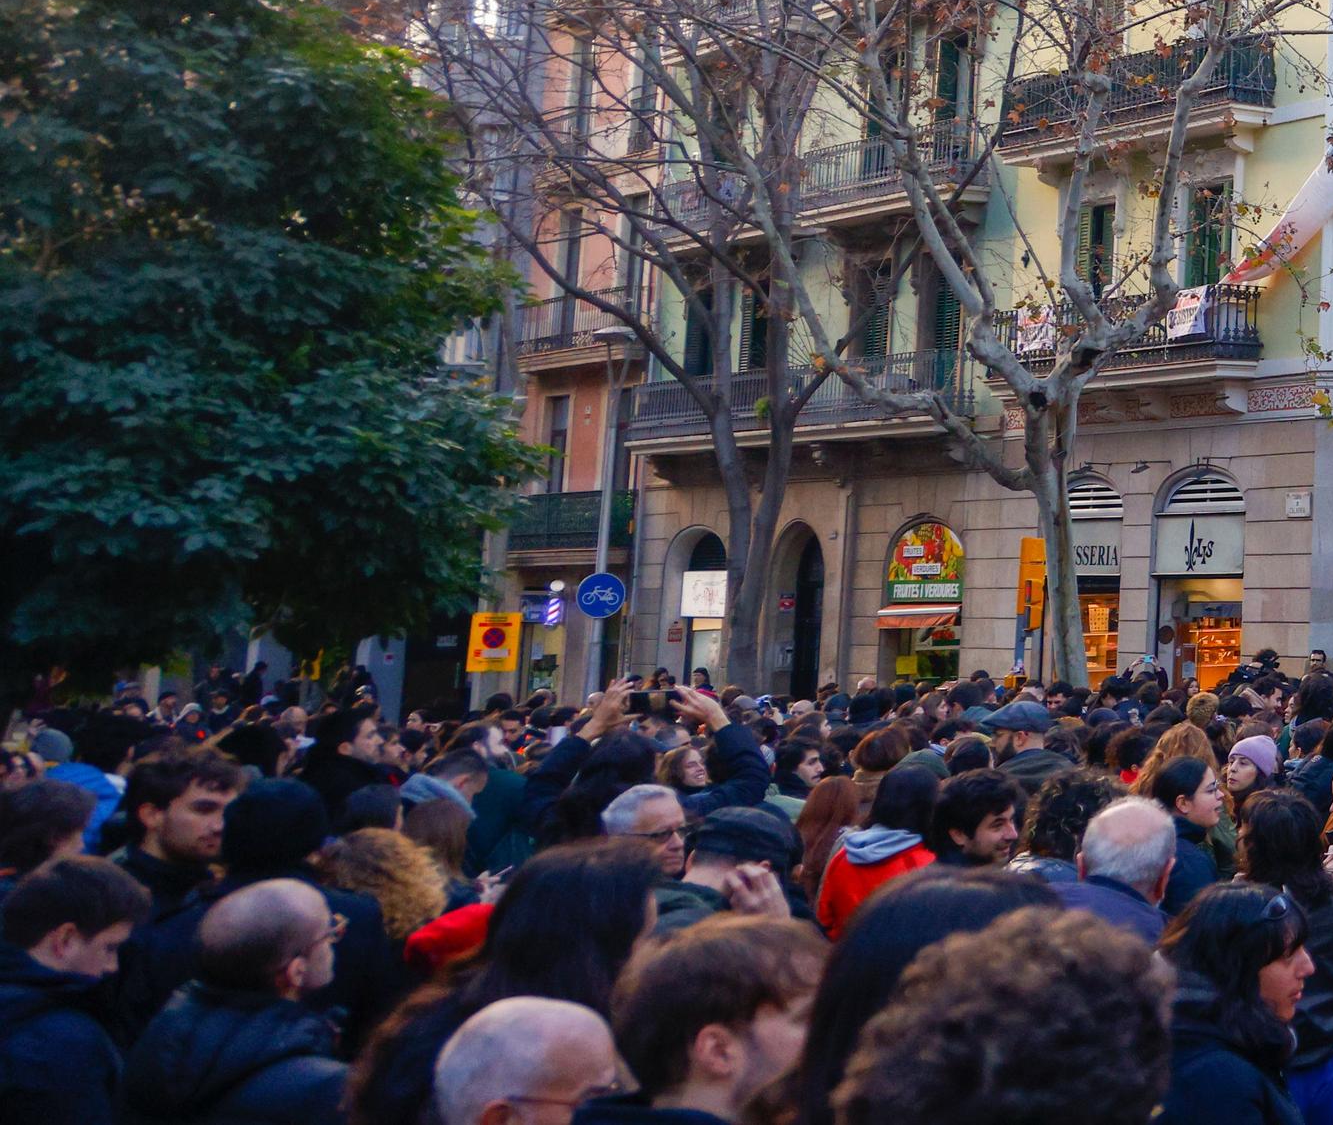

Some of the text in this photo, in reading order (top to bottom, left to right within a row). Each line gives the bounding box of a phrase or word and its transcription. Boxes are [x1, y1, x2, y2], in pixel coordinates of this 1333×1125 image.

[913, 564, 940, 573] VERDURES
[893, 583, 920, 598] FRUITES
[924, 583, 960, 598] VERDURES
